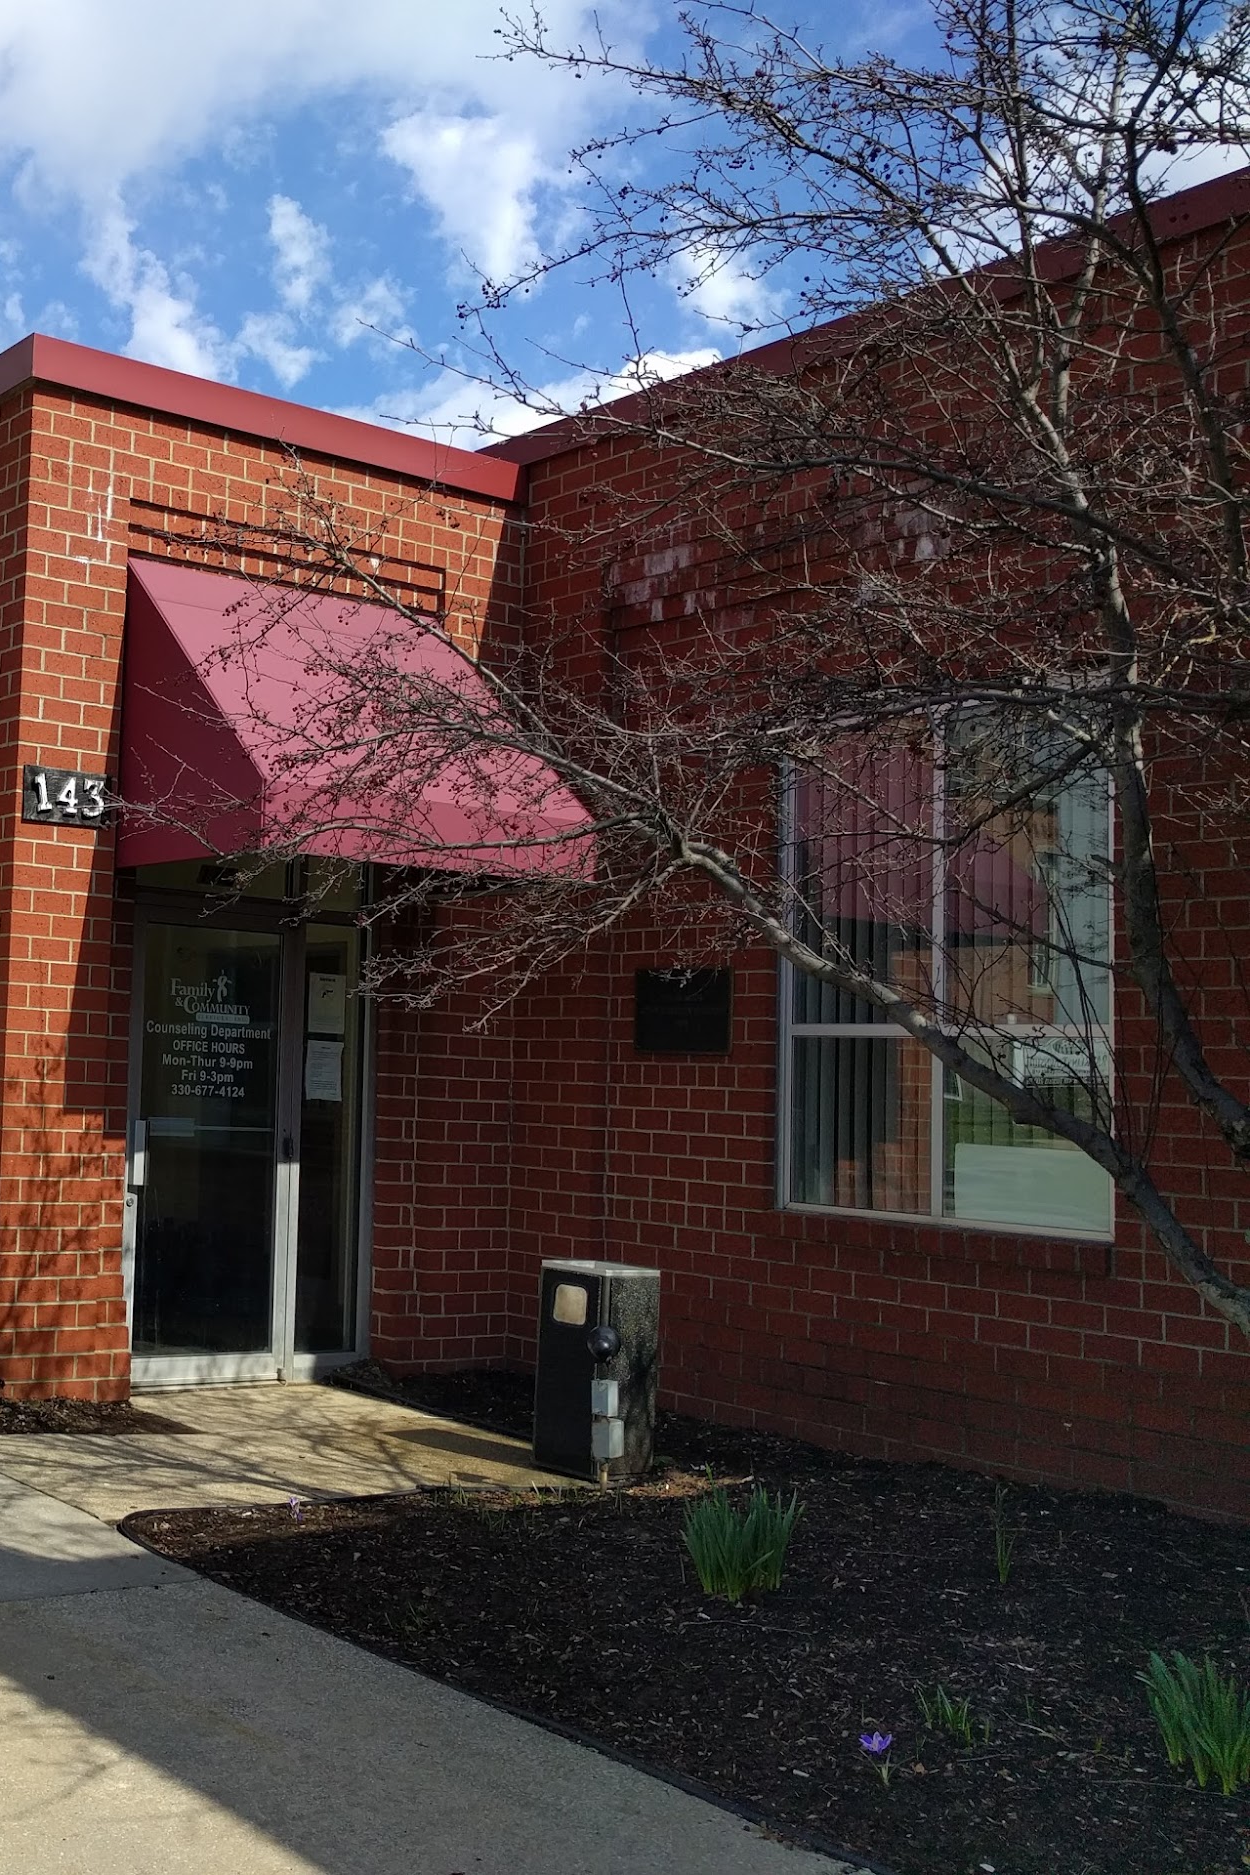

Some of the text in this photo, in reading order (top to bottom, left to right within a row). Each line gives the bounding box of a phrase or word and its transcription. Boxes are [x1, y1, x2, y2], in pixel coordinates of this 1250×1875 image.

[35, 772, 104, 817] 143
[170, 977, 215, 1002] Family
[146, 1020, 271, 1040] Counseling Department
[173, 1040, 245, 1054] OFFICE HOURS
[162, 1053, 253, 1071] Mon-Thur 9-9pm
[181, 1069, 234, 1084] Fri 9-3pm
[171, 1084, 245, 1098] 330-677-4124
